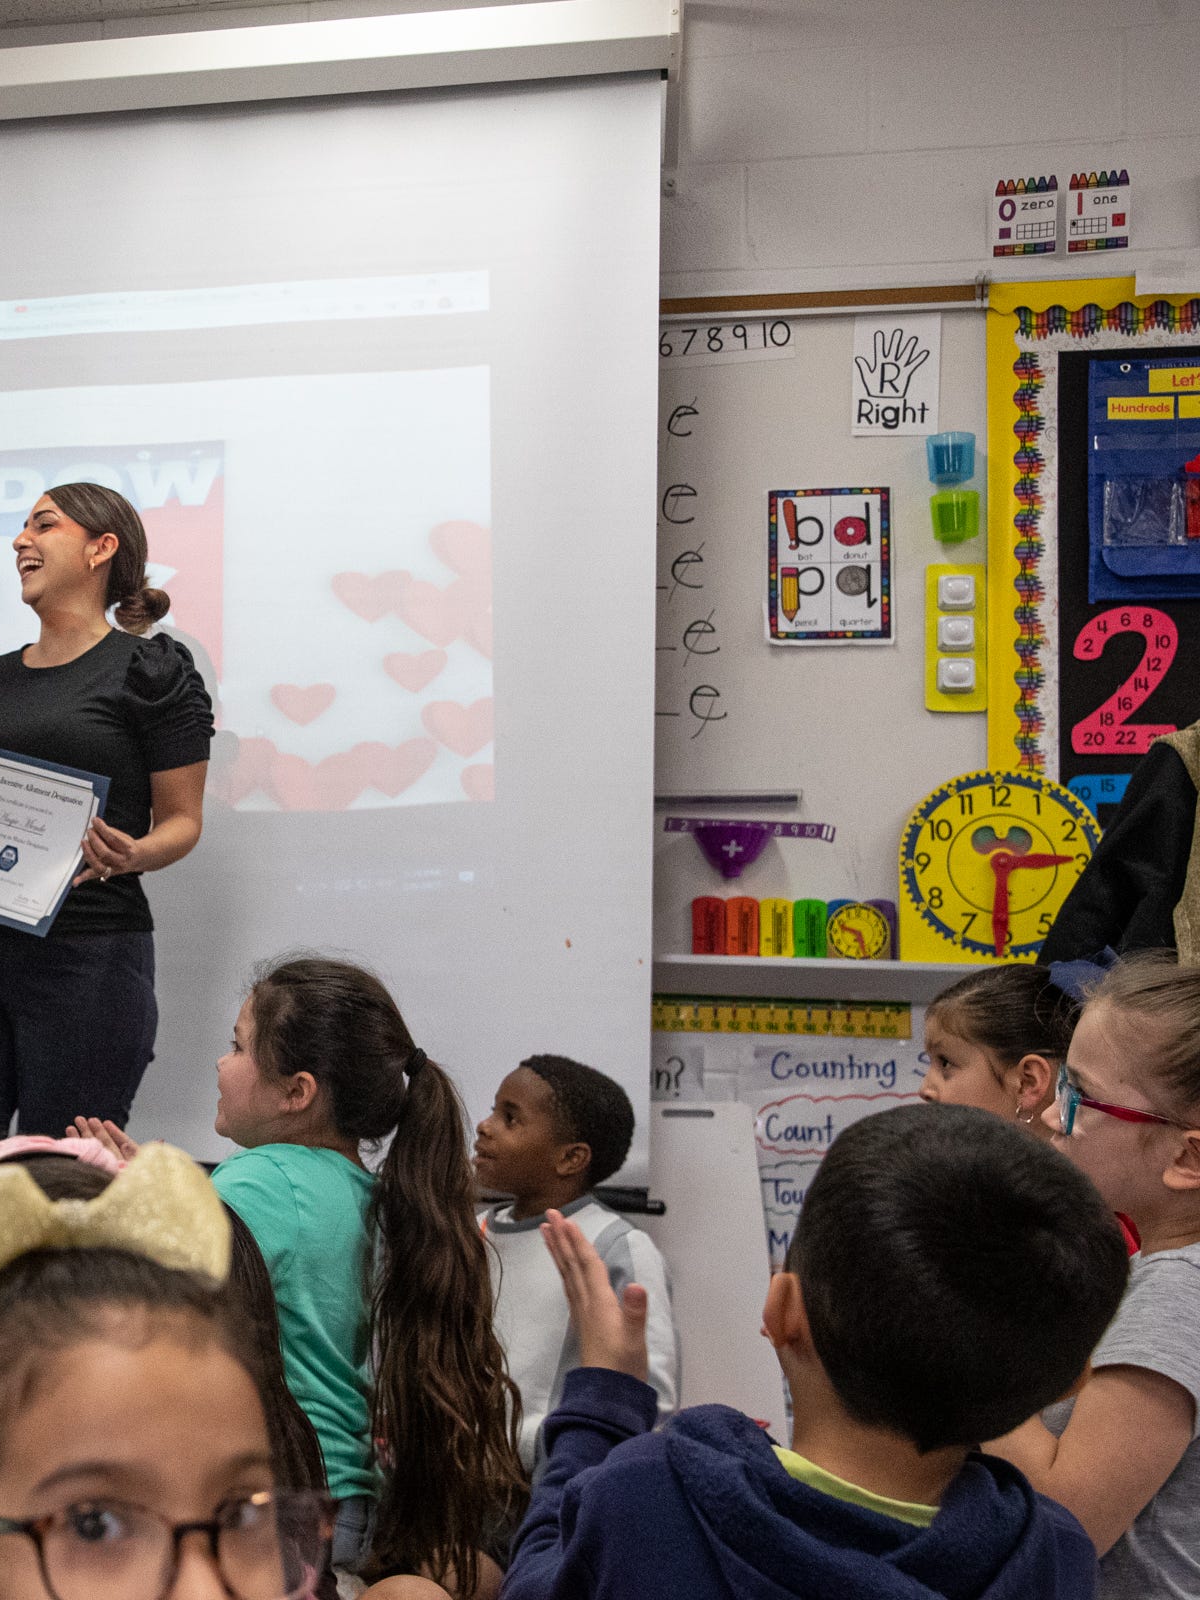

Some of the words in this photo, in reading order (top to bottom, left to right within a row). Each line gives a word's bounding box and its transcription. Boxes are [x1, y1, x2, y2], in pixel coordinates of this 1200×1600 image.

[1021, 199, 1055, 212] zero
[1093, 194, 1118, 205] one
[998, 198, 1016, 222] 0
[659, 332, 673, 357] 6
[682, 329, 698, 355] 7
[707, 326, 723, 352] 8
[732, 324, 748, 350] 9
[763, 321, 791, 348] 10
[879, 362, 901, 393] R
[857, 398, 930, 429] Right
[1111, 402, 1170, 413] Hundreds
[798, 553, 813, 561] bat
[843, 552, 868, 561] donut
[794, 619, 818, 628] pencil
[839, 618, 874, 627] quarter
[1097, 620, 1108, 634] 4
[1120, 613, 1131, 627] 6
[1143, 614, 1154, 628] 8
[1083, 638, 1094, 652] 2
[1155, 634, 1171, 649] 10
[1146, 657, 1162, 671] 12
[1134, 677, 1150, 692] 14
[1117, 697, 1133, 711] 16
[1099, 712, 1115, 726] 18
[1083, 732, 1105, 746] 20
[1115, 730, 1137, 745] 22
[1101, 778, 1116, 793] 15
[24, 783, 51, 797] Allotment
[50, 790, 84, 807] Designation
[989, 785, 1011, 807] 12
[958, 794, 974, 815] 11
[1033, 794, 1042, 815] 1
[681, 820, 689, 831] 2
[775, 824, 782, 835] 8
[791, 824, 799, 836] 9
[806, 825, 818, 836] 10
[929, 819, 952, 841] 10
[1061, 819, 1078, 842] 2
[915, 852, 931, 874] 9
[928, 886, 943, 909] 8
[961, 912, 978, 935] 7
[1037, 912, 1053, 935] 5
[770, 1051, 897, 1088] Counting
[765, 1113, 834, 1142] Count
